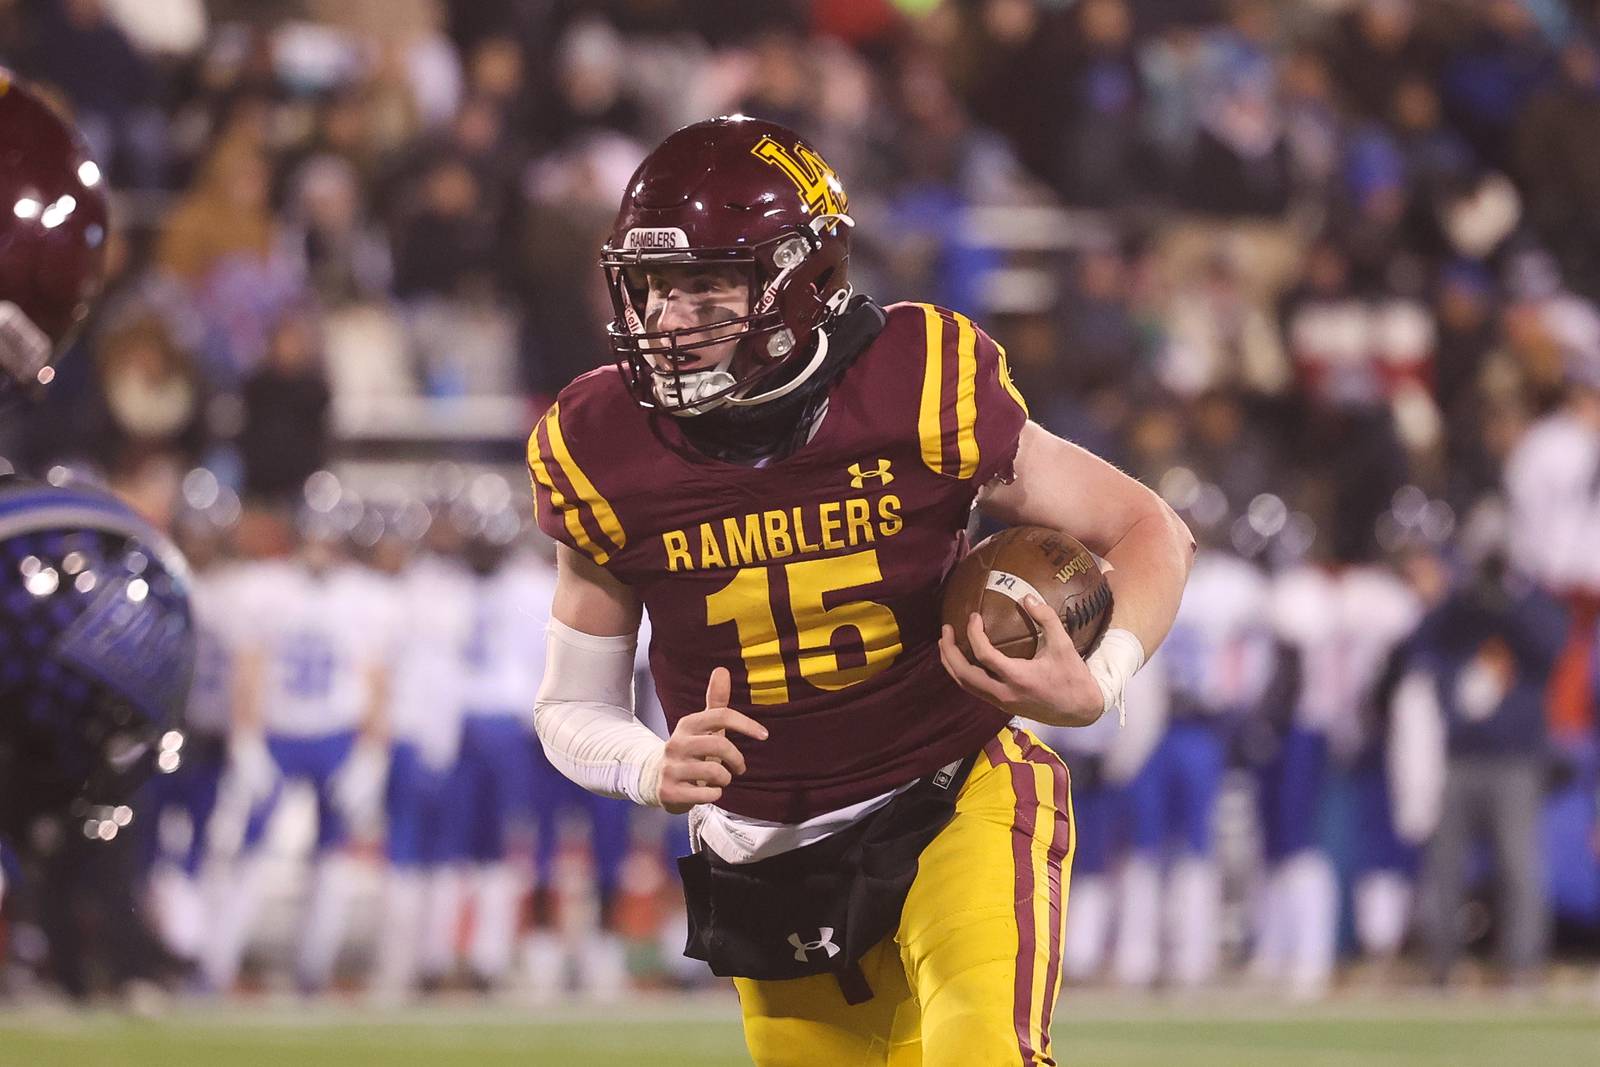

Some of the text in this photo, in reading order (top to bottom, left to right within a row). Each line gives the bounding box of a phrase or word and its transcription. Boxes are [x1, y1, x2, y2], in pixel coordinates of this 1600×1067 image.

[630, 231, 677, 248] RAMBLERS
[662, 494, 903, 572] RAMBLERS
[1055, 552, 1093, 584] Wilson
[705, 549, 903, 705] 15
